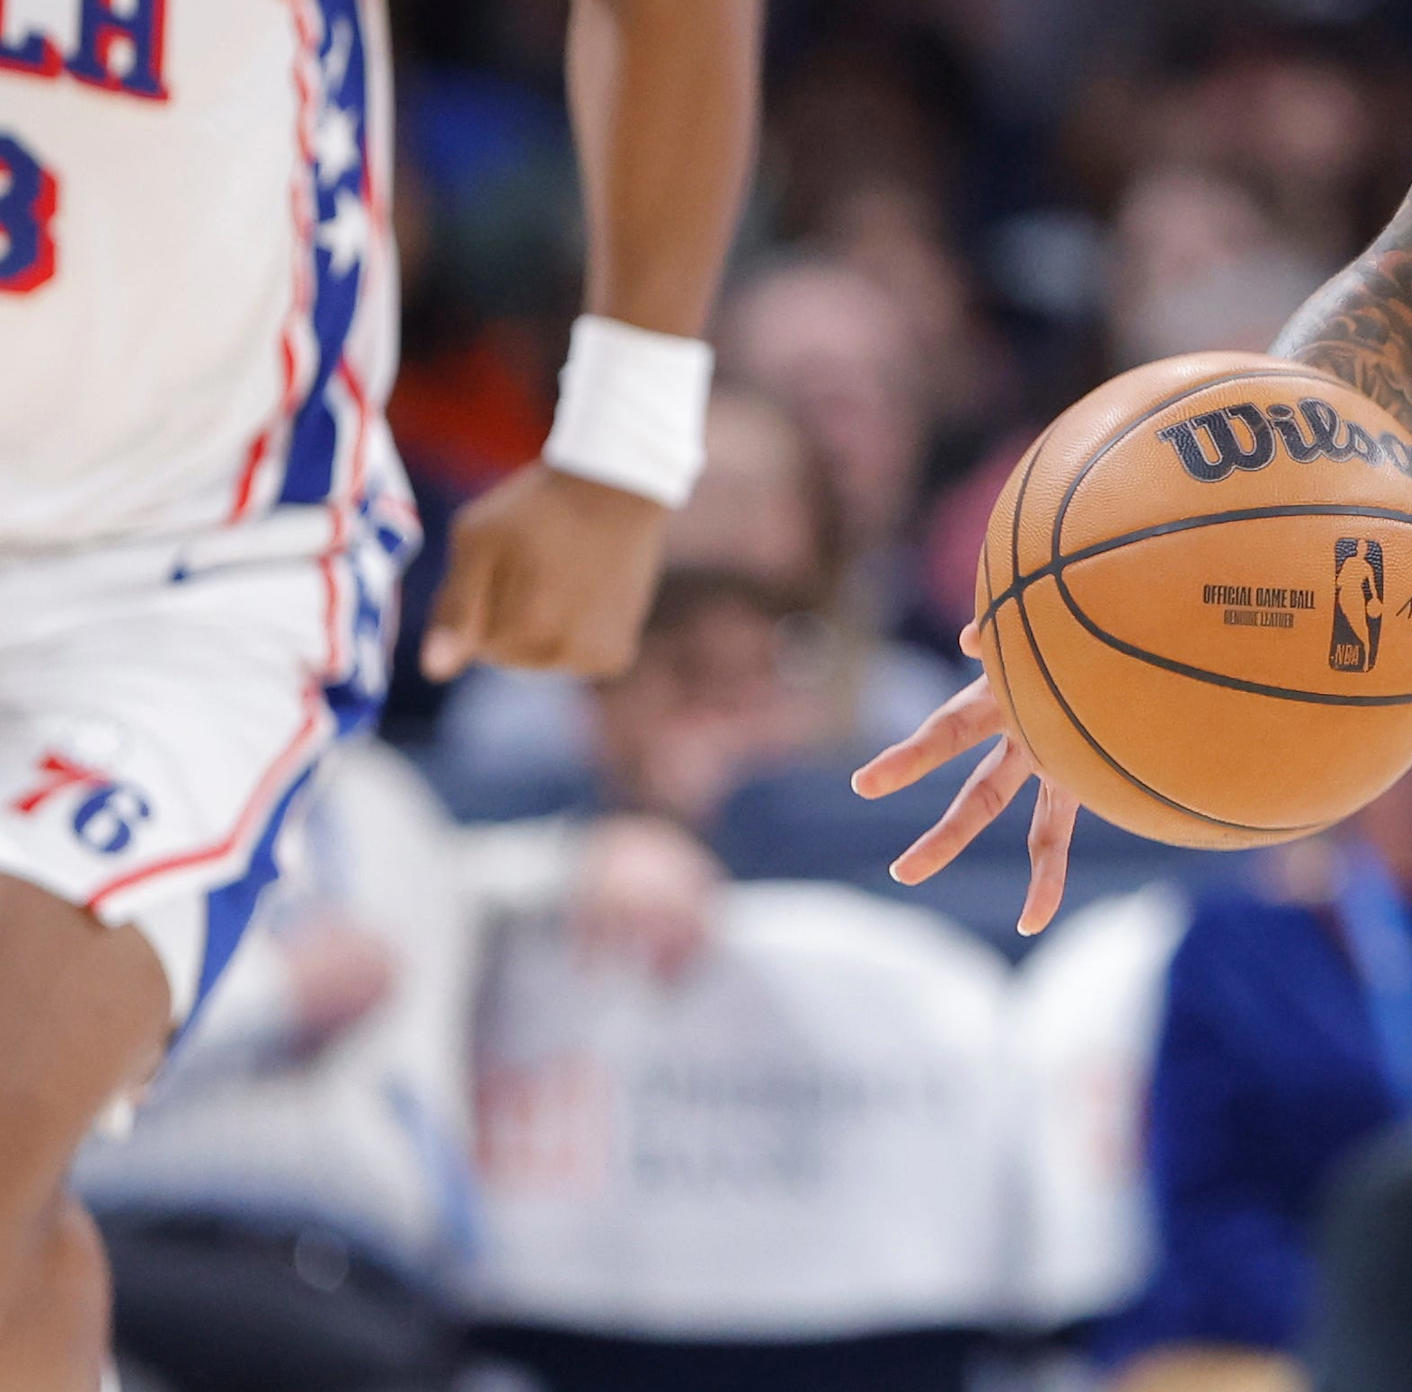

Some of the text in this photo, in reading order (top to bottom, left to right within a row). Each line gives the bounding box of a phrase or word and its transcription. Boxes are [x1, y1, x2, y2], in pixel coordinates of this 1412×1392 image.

[1203, 583, 1316, 610] OFFICIAL GAME BALL
[1334, 644, 1360, 666] NBA
[15, 751, 153, 855] 76
